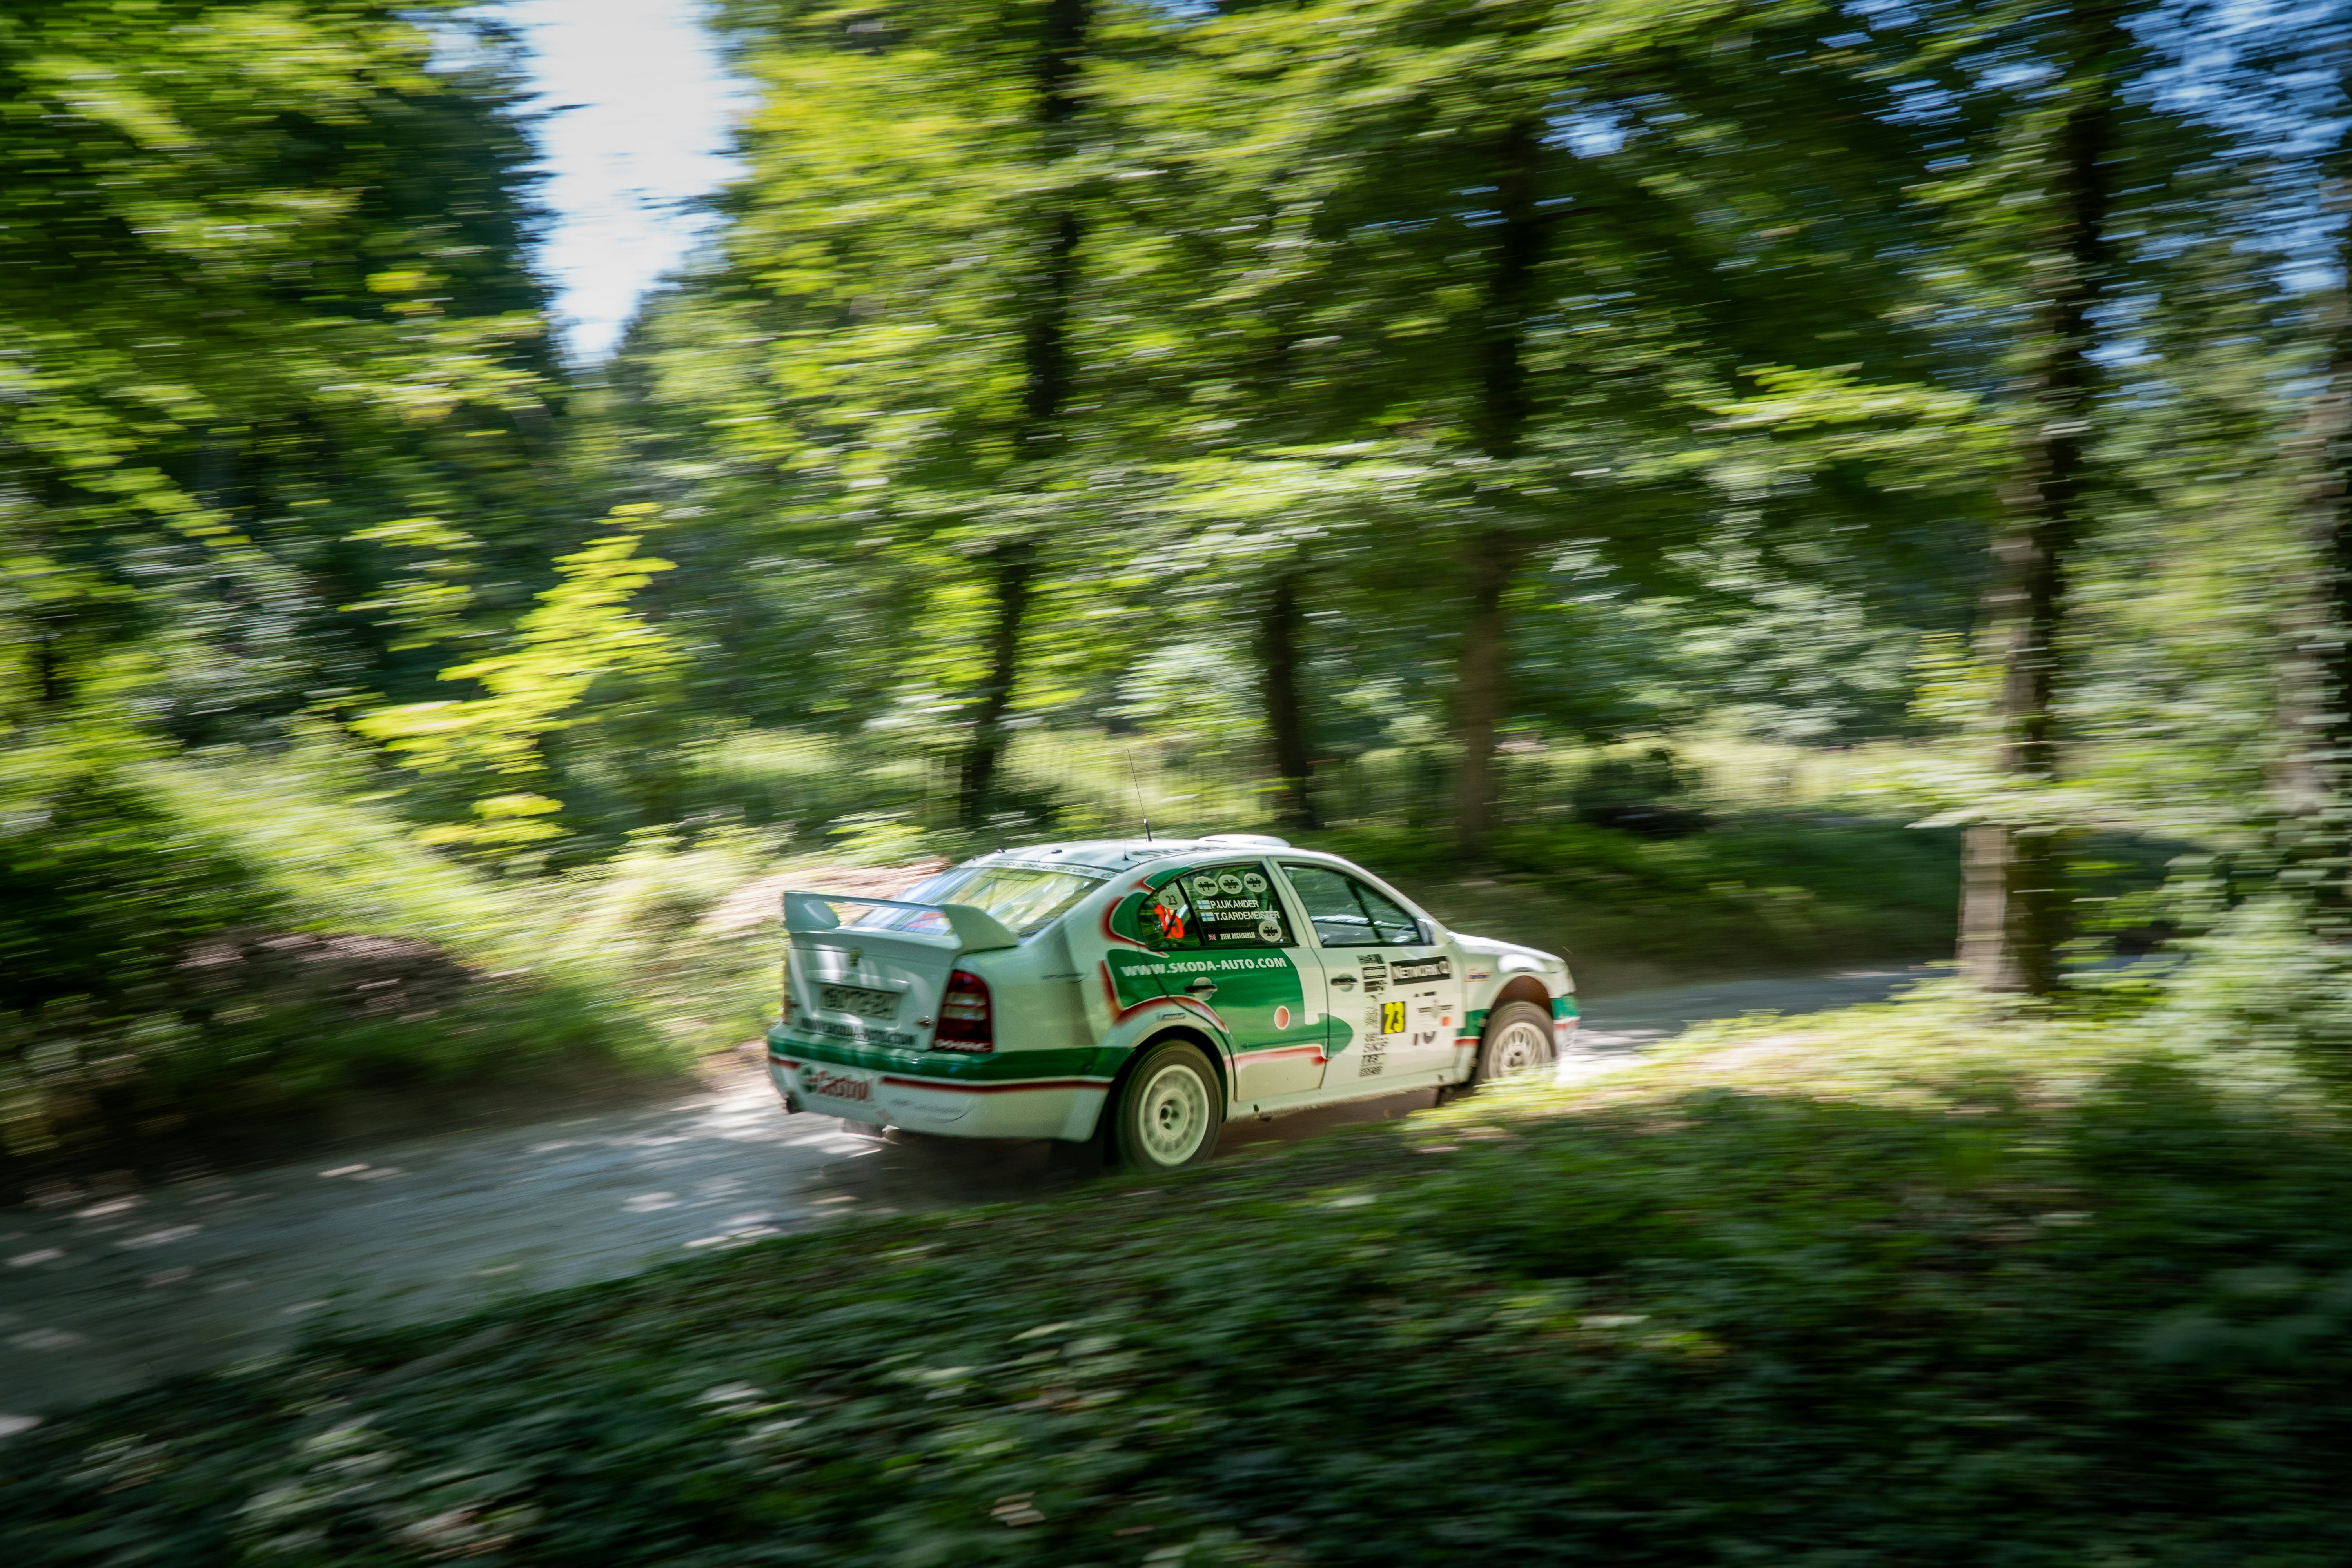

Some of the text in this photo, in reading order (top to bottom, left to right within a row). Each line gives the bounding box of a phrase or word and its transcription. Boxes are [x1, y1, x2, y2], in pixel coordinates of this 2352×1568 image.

[1166, 895, 1178, 905] 23
[1210, 900, 1259, 909] P.LUKANDER
[1214, 911, 1280, 921] T.GARDEMEISTER
[1120, 957, 1287, 977] WWW.SKODA-AUTO.COM
[1392, 964, 1439, 980] NETWORK
[1384, 1001, 1405, 1034] 23
